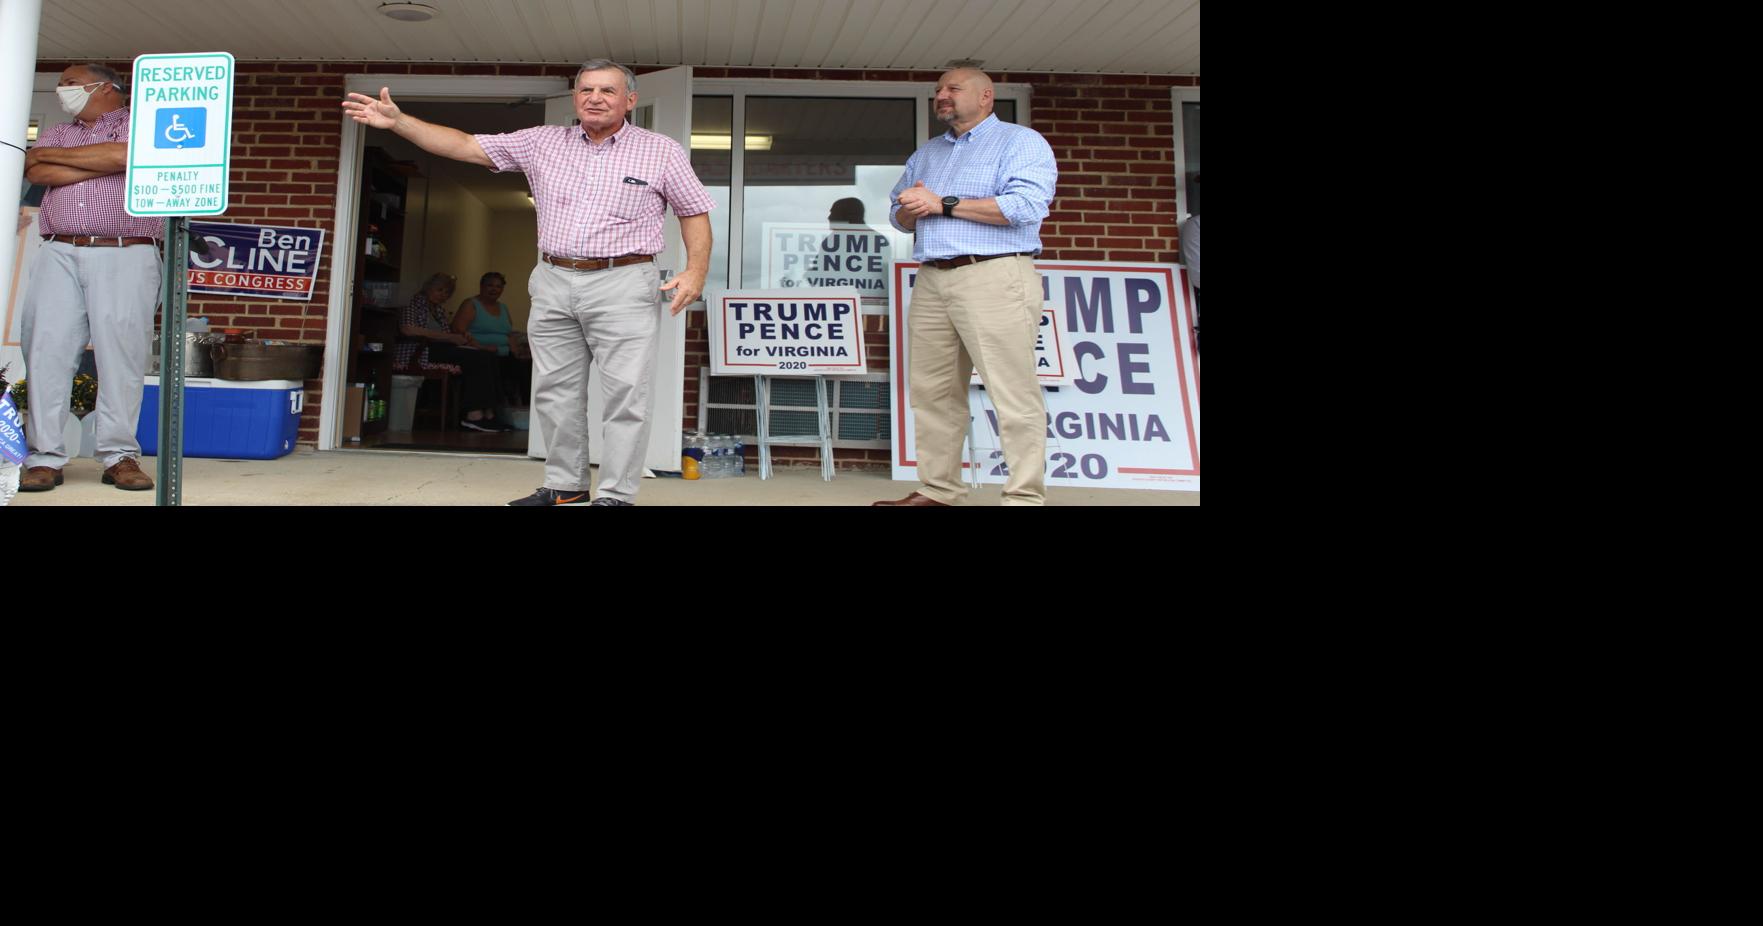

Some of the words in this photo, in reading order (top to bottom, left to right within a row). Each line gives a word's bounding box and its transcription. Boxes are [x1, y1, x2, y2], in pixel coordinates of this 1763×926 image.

[141, 66, 225, 82] RESERVED
[145, 86, 219, 102] PARKING
[157, 171, 199, 182] PENALTY
[200, 183, 220, 194] FINE
[195, 197, 218, 207] ZONE
[258, 228, 311, 250] Ben
[775, 233, 890, 254] TRUMP
[190, 235, 308, 273] CLINE
[783, 253, 883, 272] PENCE
[214, 273, 304, 290] CONGRESS
[729, 303, 851, 321] TRUMP
[739, 323, 844, 340] PENCE
[736, 345, 760, 357] for
[765, 346, 848, 357] VIRGINIA
[778, 361, 807, 370] 2020
[985, 409, 1171, 442] VGINIA
[989, 451, 1108, 480] 220
